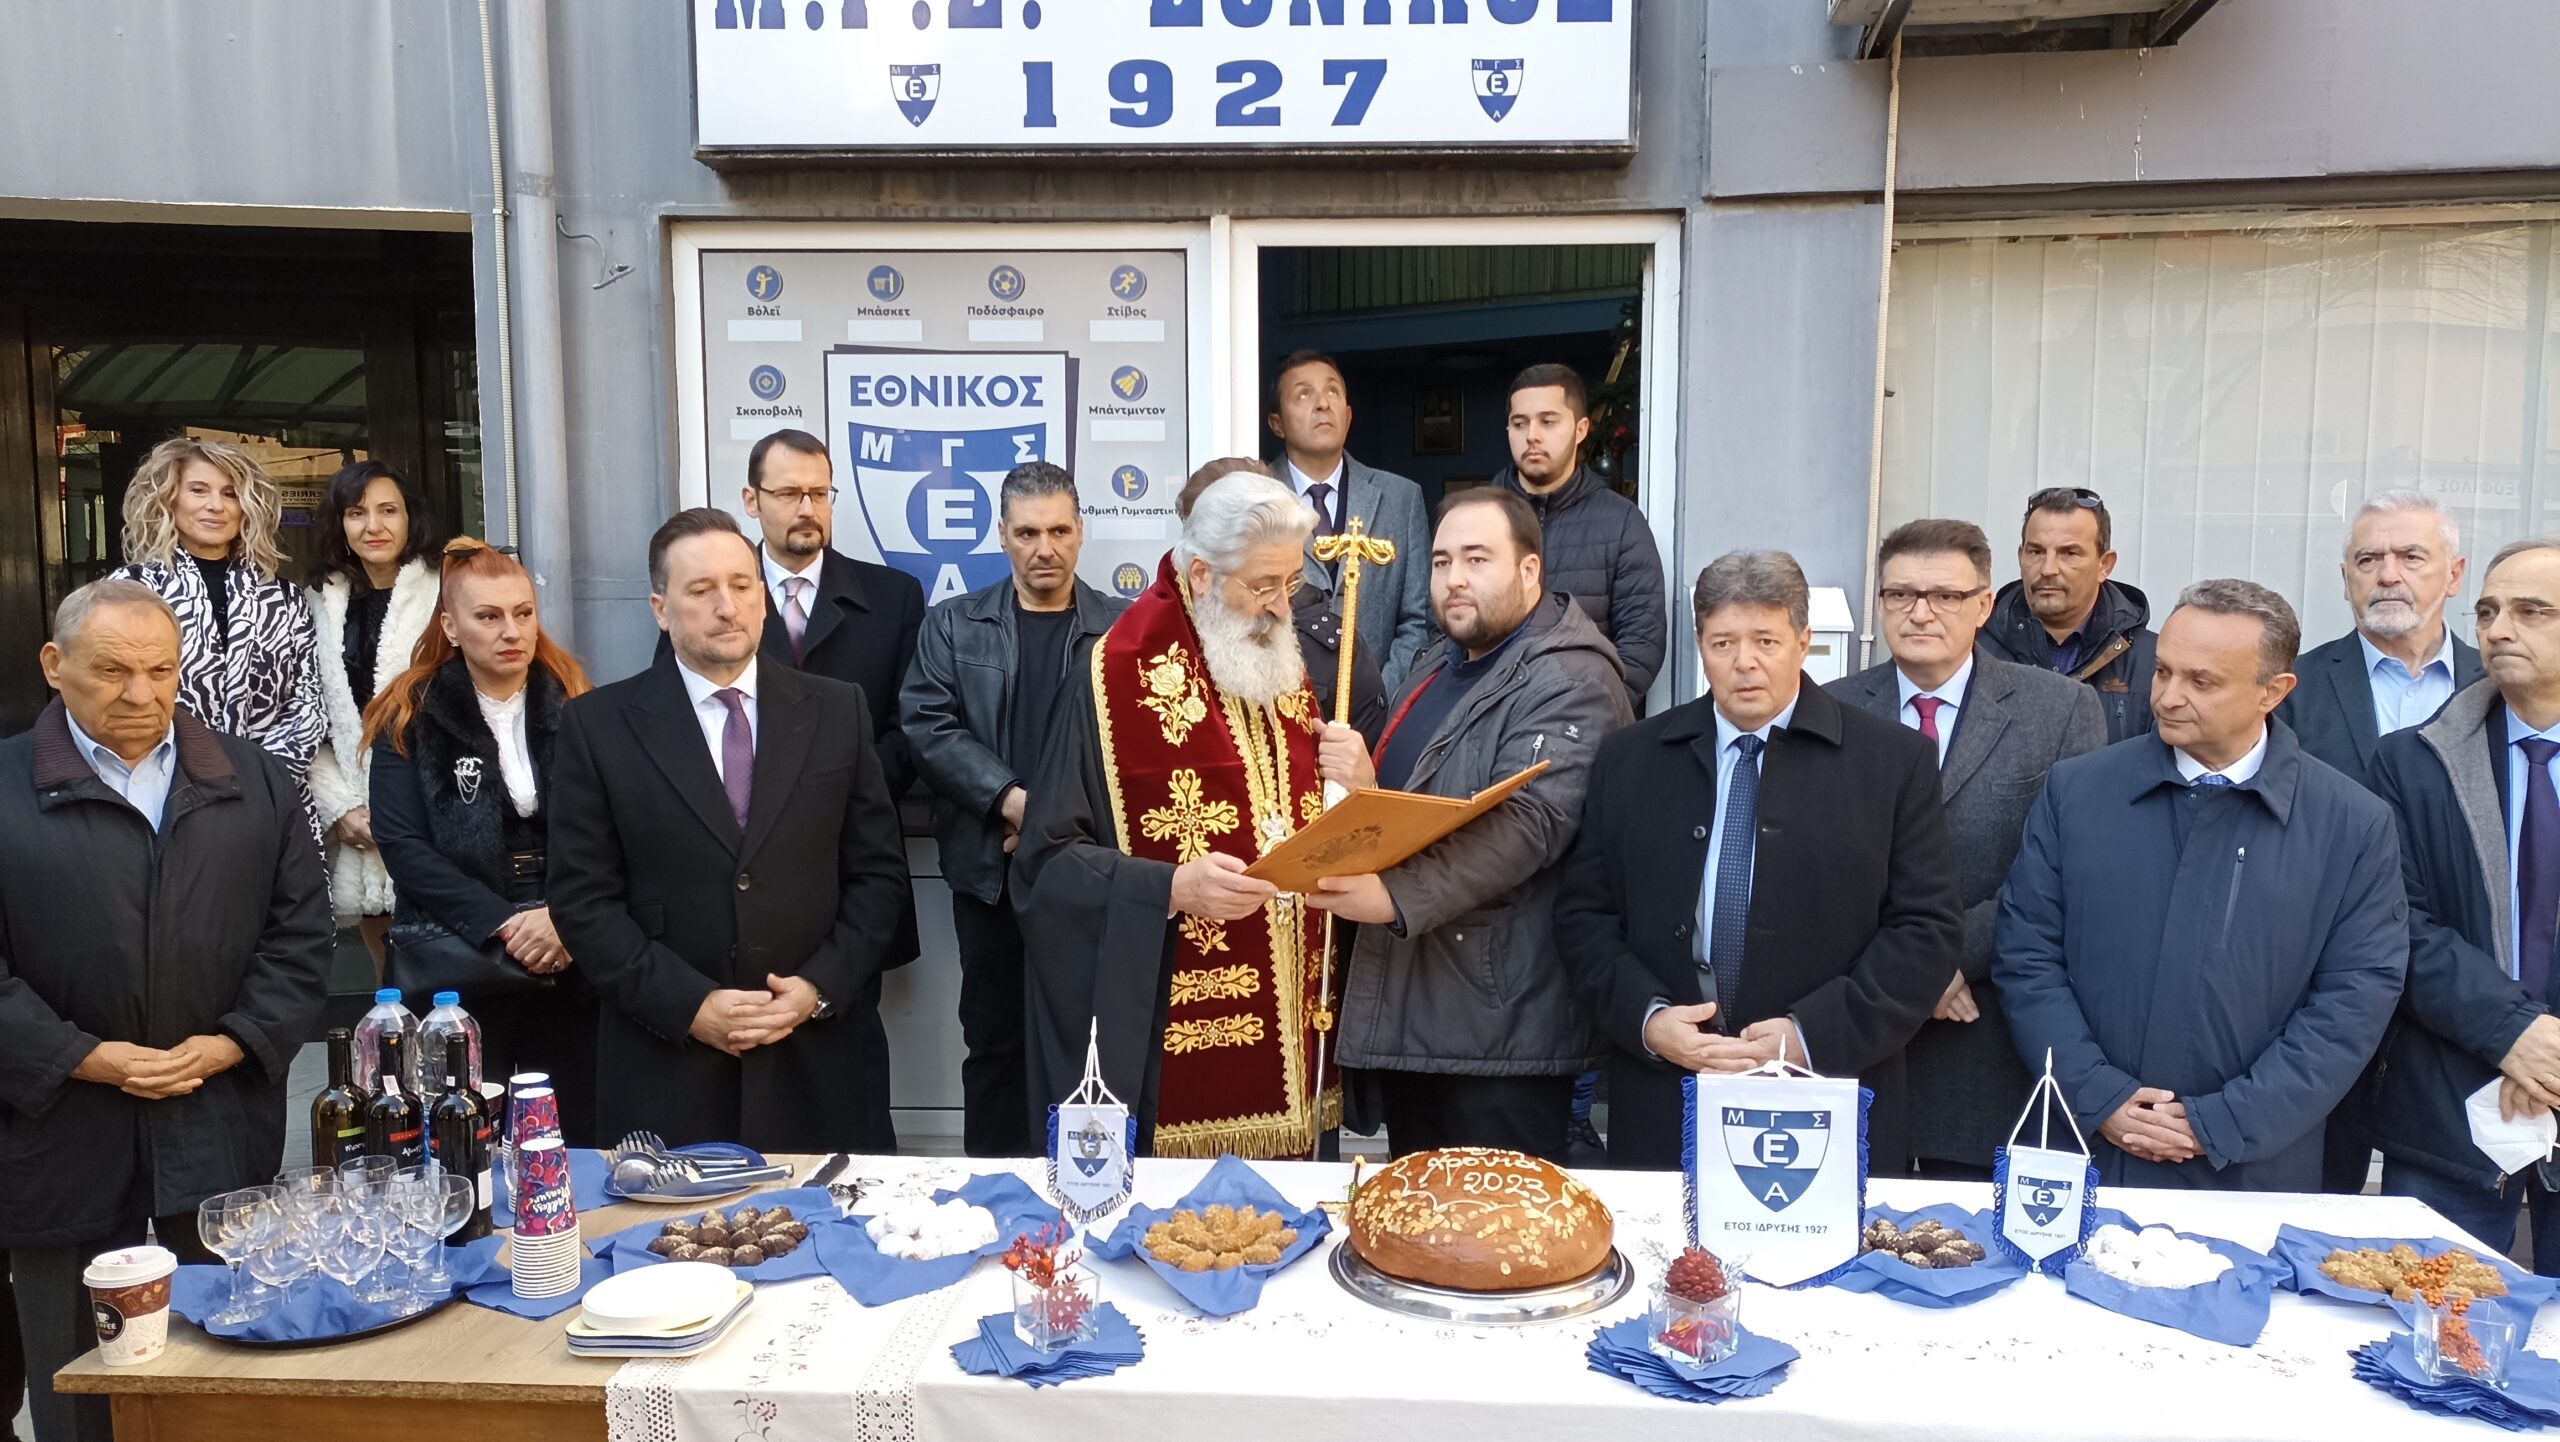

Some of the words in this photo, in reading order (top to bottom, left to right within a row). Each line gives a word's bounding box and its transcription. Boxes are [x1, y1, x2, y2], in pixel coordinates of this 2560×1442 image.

[1023, 59, 1388, 128] 1927
[857, 304, 911, 317] Μπάσκετ
[967, 305, 1045, 318] Ποδόσφαιρο
[1107, 305, 1147, 318] Στίβος
[850, 374, 1044, 408] ΕΘΝΙΚΟΣ
[736, 404, 803, 418] Σκοποβολή
[1089, 404, 1166, 416] Μπάντμιντον
[927, 489, 977, 540] Ε
[1463, 1171, 1551, 1203] 2023
[1724, 1221, 1752, 1232] ΕΤΟΣ
[1755, 1222, 1801, 1234] ΙΔΡΥΣΗΣ
[1805, 1224, 1828, 1234] 1927
